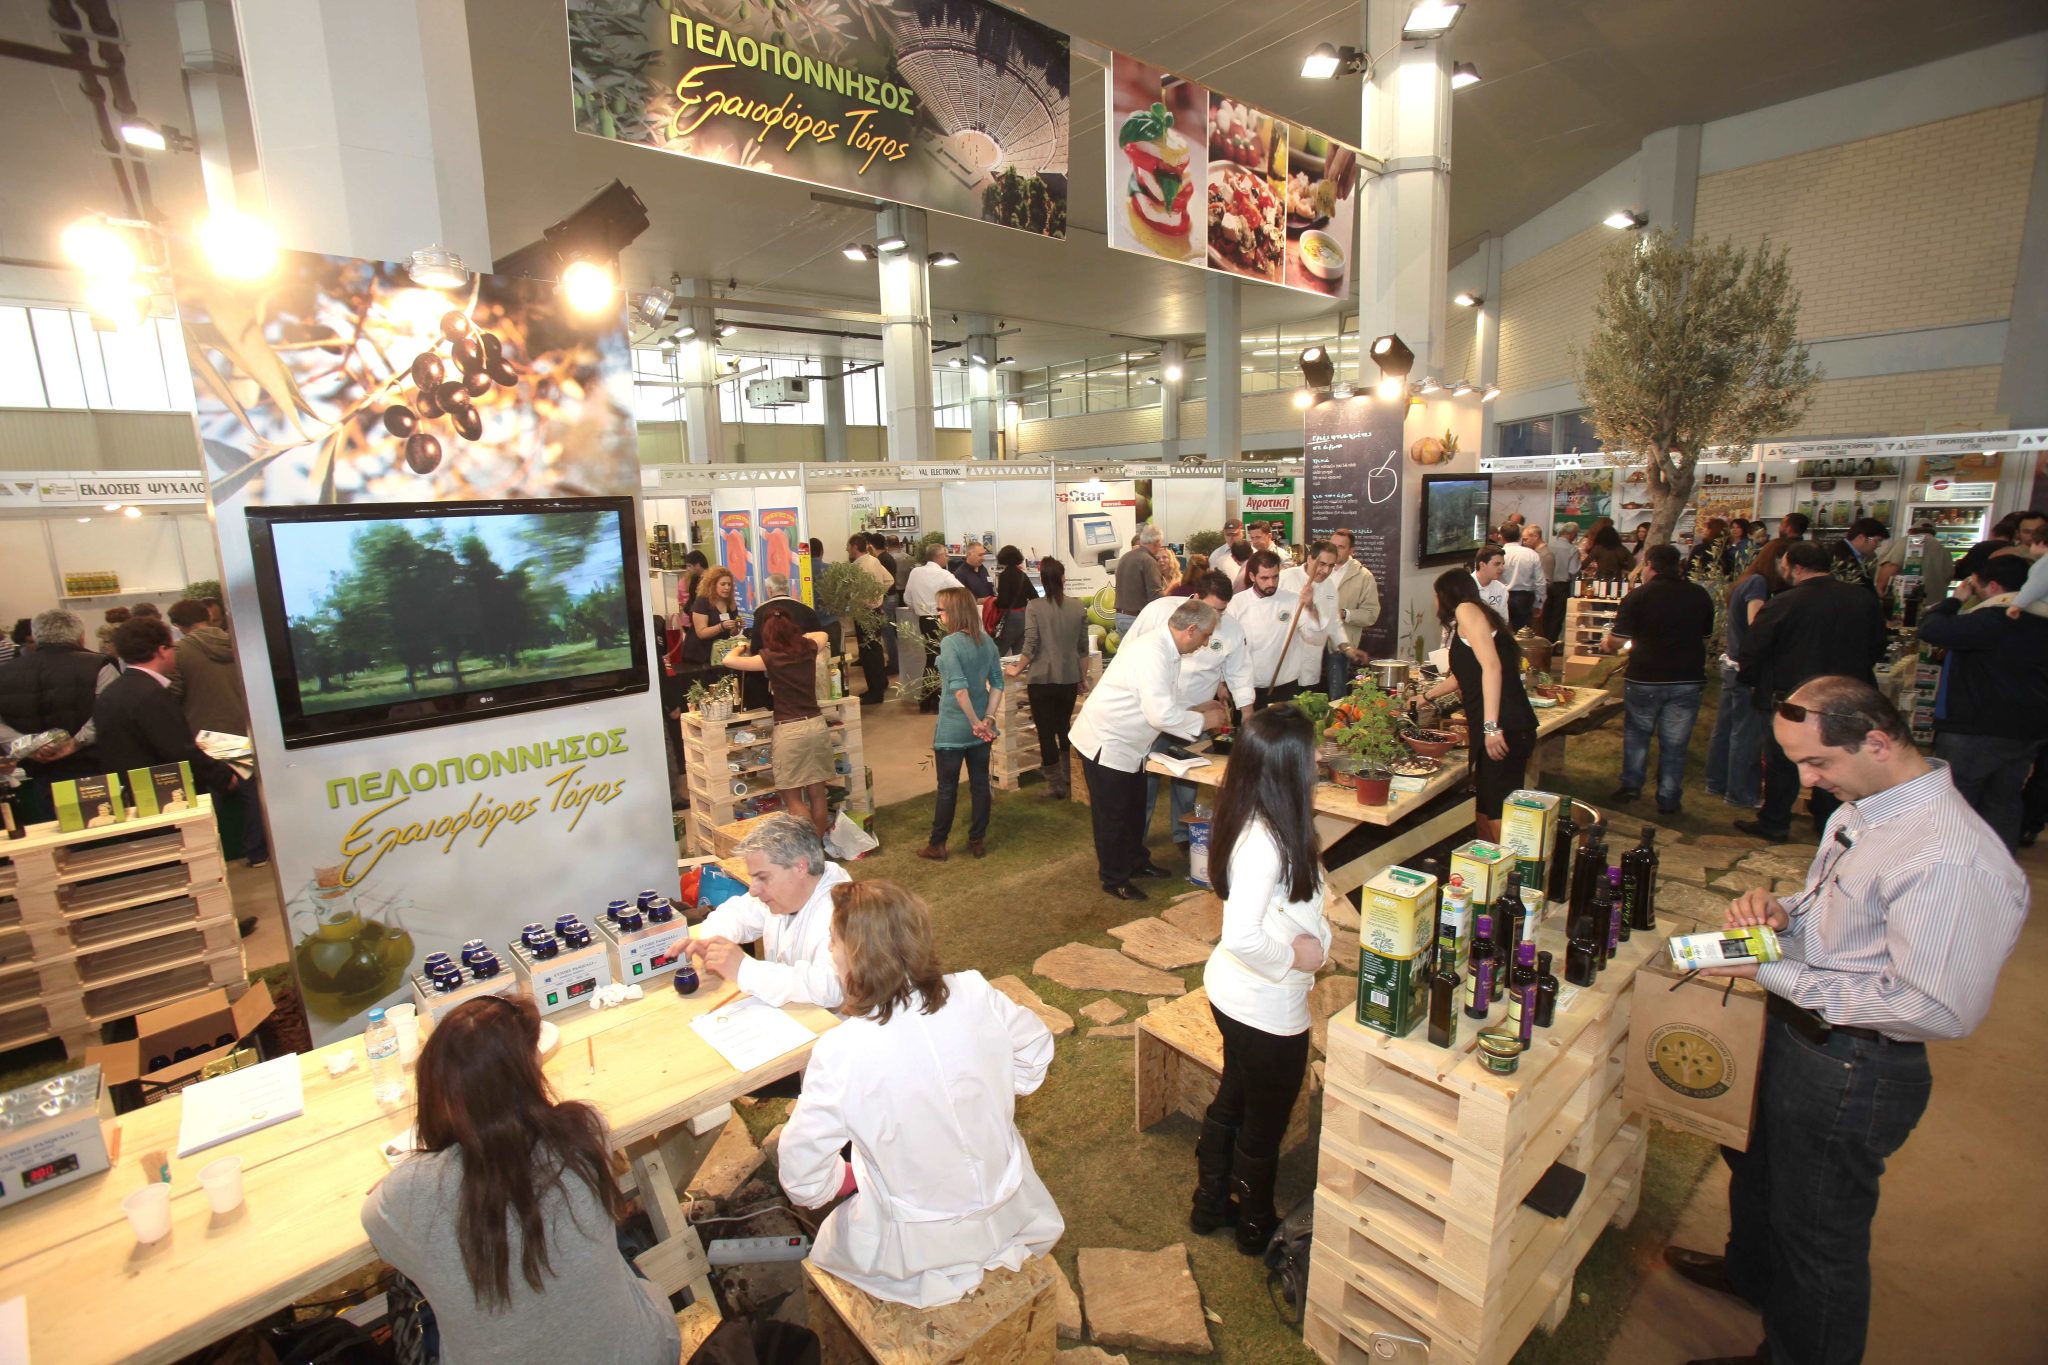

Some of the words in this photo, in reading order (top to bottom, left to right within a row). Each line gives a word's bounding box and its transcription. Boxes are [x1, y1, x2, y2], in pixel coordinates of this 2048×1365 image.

[669, 13, 915, 116] ΠΕΛΟΠΟΝΝΗΣΟΣ
[672, 64, 840, 152] Ελαιοφόρος
[845, 110, 910, 175] Τόπος
[80, 483, 142, 496] ΕΚΔΟΣΕΙΣ
[930, 468, 961, 476] ELECTRONIC
[1246, 495, 1290, 510] Αγροτική
[326, 727, 629, 809] ΠΕΛΟΠΟΝΝΗΣΟΣ
[339, 792, 541, 887] Ελαιοφόρος
[545, 764, 626, 832] Τόπος
